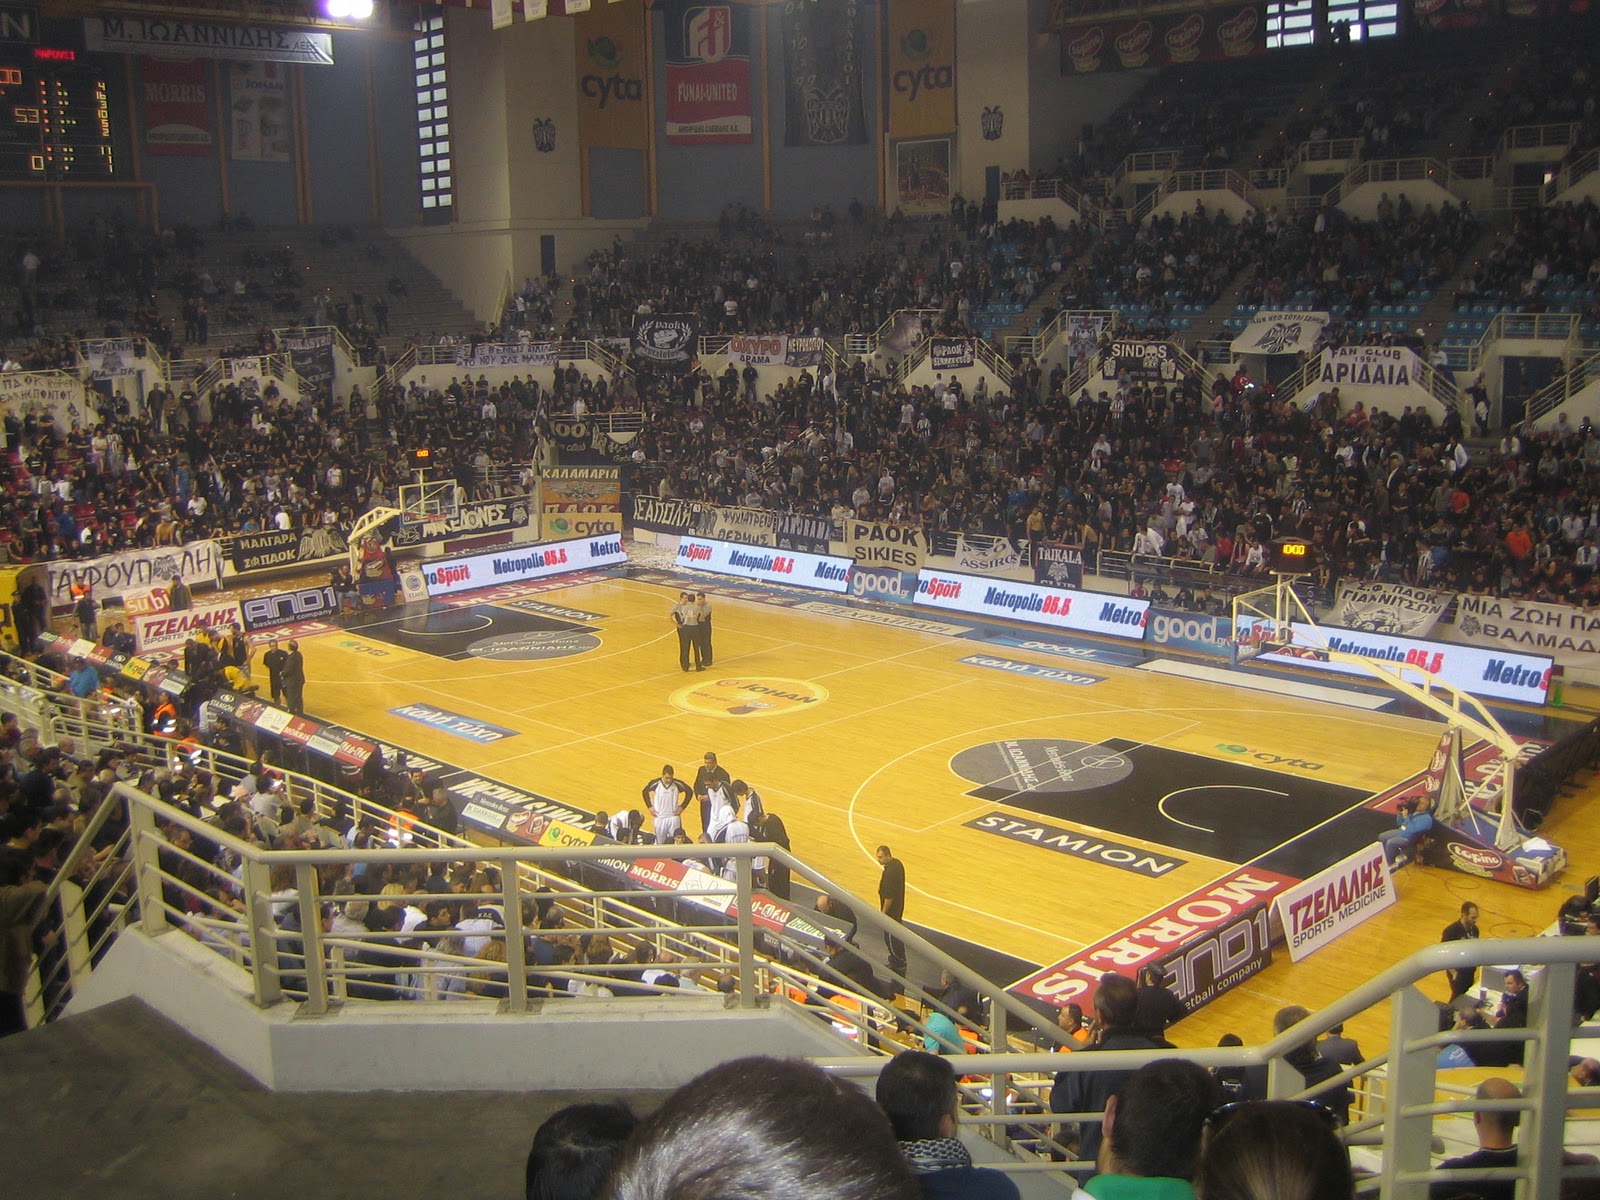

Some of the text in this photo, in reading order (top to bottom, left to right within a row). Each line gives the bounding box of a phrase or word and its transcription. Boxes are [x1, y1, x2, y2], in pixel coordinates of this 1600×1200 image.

[581, 74, 642, 108] cyta
[893, 63, 954, 101] cyta
[739, 356, 770, 364] ΔΡΑΜΑ
[1331, 348, 1401, 360] FAN CLUB
[1321, 363, 1410, 386] ΑΡΙΔΑΙΑ
[543, 468, 619, 479] ΚΑΛΑΜΑΡΙΑ
[575, 521, 615, 536] cyta
[854, 523, 919, 547] PAOK
[240, 532, 298, 550] ΜΑΛΓΑΡΑ
[854, 546, 917, 566] SIKIES
[1038, 547, 1082, 565] TRIKALA
[253, 608, 333, 628] basketball company
[511, 600, 601, 622] STAMION
[1462, 597, 1503, 618] ΜΙΑ
[1509, 606, 1562, 628] ΖΩΗ
[144, 633, 184, 645] SPORTS
[737, 683, 819, 704] JOHAN
[1253, 751, 1325, 772] cyta
[975, 813, 1177, 878] STAMION
[1453, 845, 1500, 866] topino
[630, 865, 680, 889] MORRIS
[1293, 885, 1387, 950] SPORTS MEDICINE
[1031, 873, 1280, 1003] MORRIS
[1184, 956, 1263, 1010] etball company
